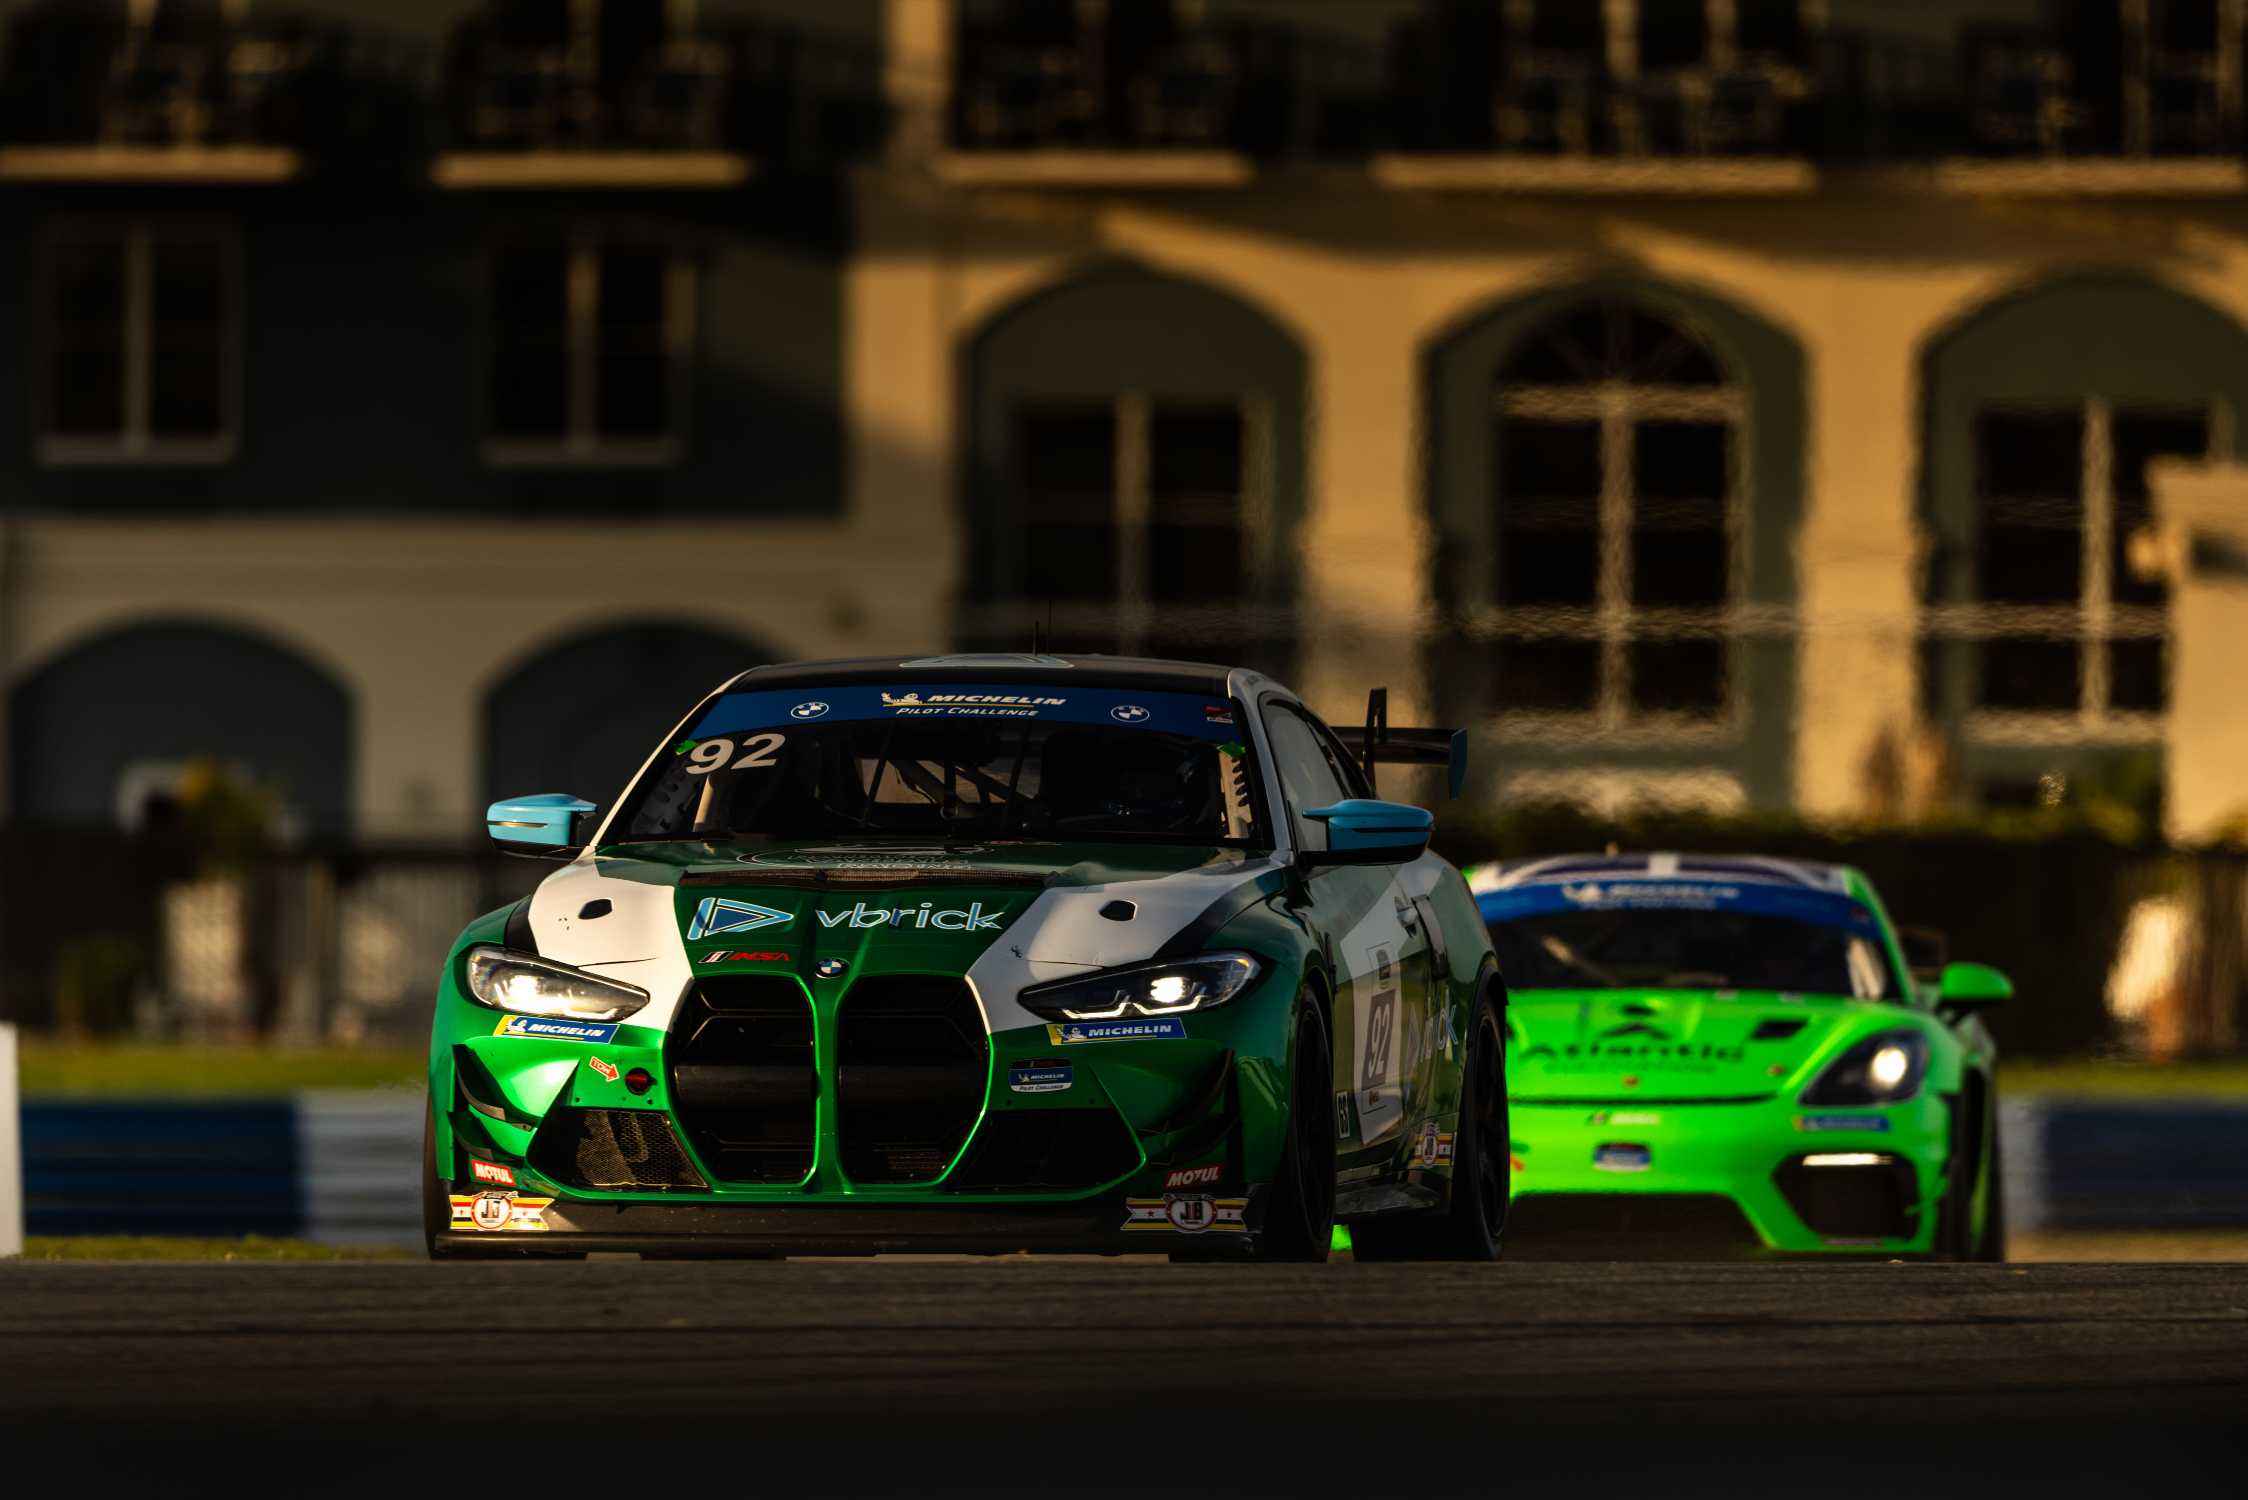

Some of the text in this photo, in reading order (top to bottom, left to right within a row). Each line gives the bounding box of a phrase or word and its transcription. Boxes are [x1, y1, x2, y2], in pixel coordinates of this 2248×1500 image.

[927, 694, 1067, 705] MICHELIN
[896, 706, 1040, 717] PILOT CHALLENGE
[685, 733, 786, 775] 92
[815, 902, 1005, 931] vbrick
[528, 1023, 606, 1037] MICHELIN
[1088, 1024, 1172, 1037] MICHELIN
[1368, 1003, 1391, 1079] 92
[475, 1163, 514, 1185] MOTUL
[1167, 1167, 1219, 1187] MOTUL
